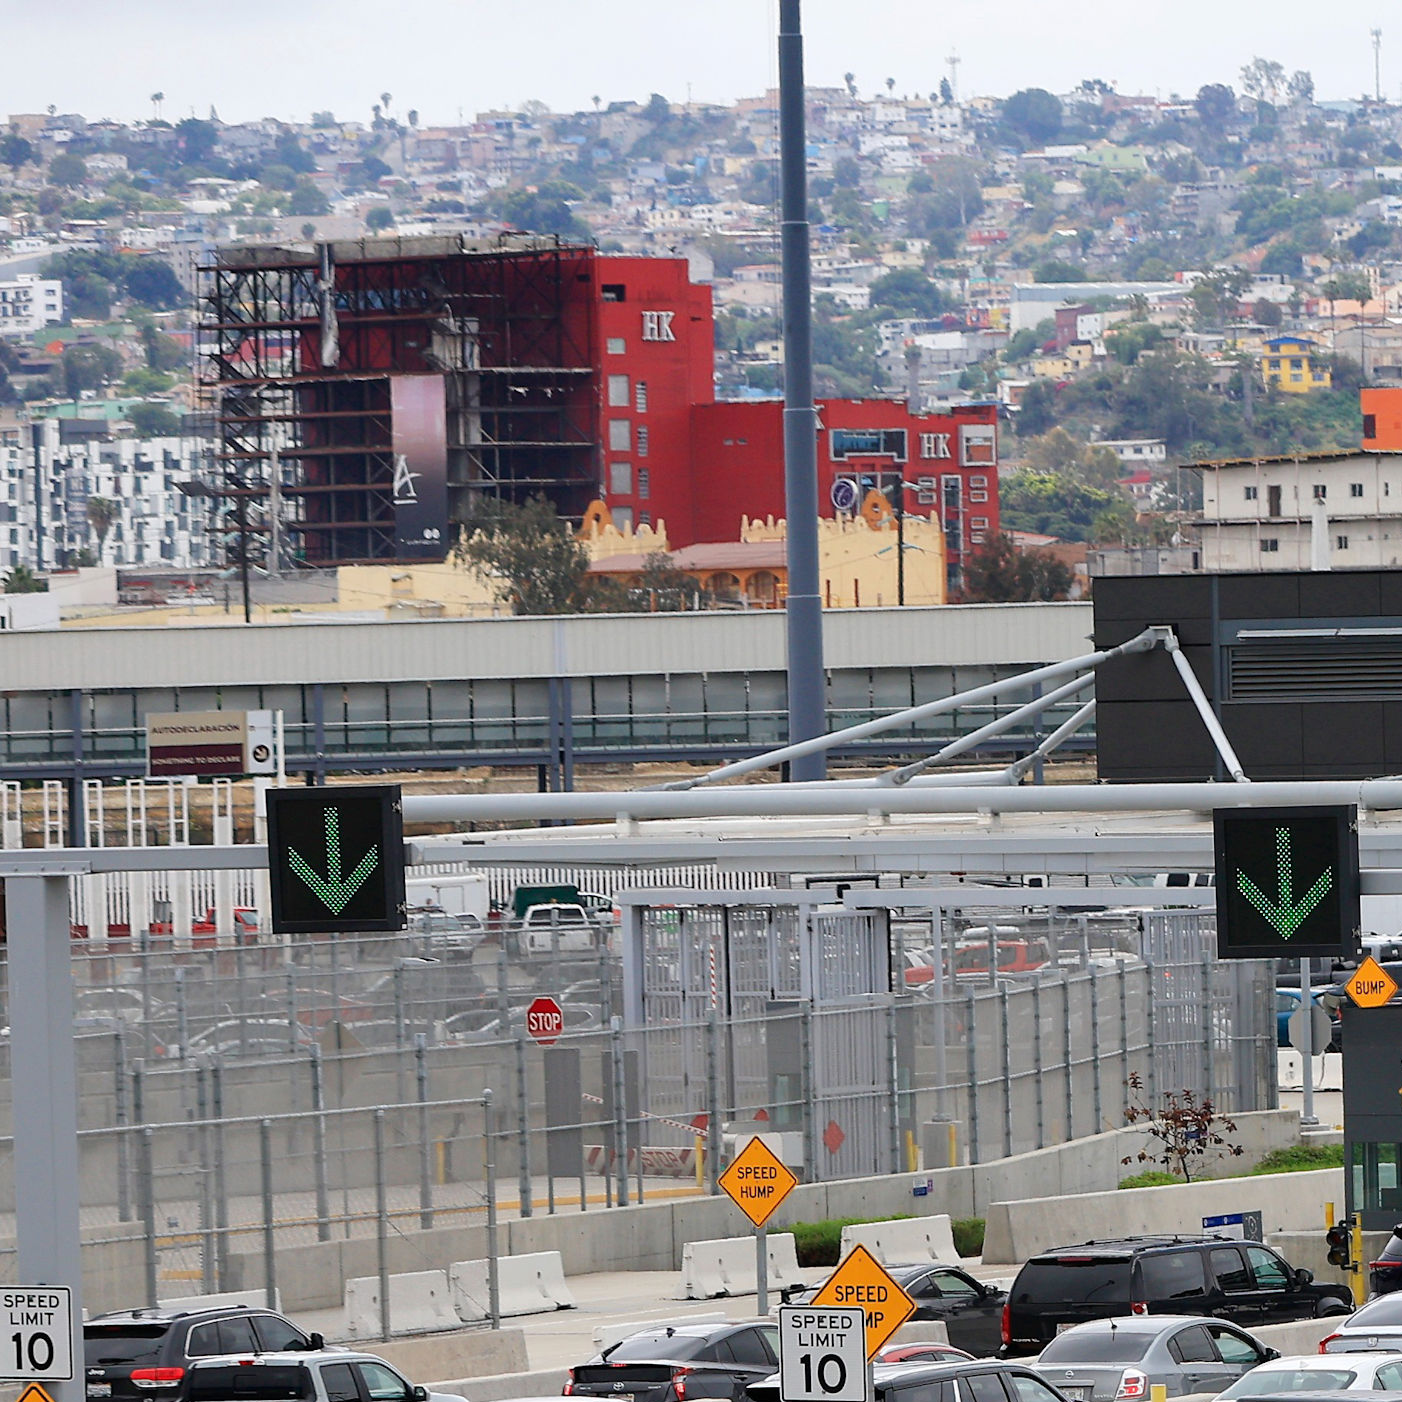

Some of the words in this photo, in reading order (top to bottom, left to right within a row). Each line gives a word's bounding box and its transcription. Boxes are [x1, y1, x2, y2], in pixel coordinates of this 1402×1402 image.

[642, 311, 676, 341] HK
[920, 433, 951, 459] HK
[1355, 981, 1386, 995] BUMP
[528, 1011, 559, 1031] STOP
[737, 1166, 777, 1180] SPEED
[740, 1186, 774, 1199] HUMP
[835, 1285, 888, 1302] SPEED
[3, 1295, 59, 1309] SPEED
[10, 1312, 54, 1326] LIMIT
[791, 1315, 853, 1330] SPEED
[865, 1311, 886, 1328] MP
[799, 1334, 846, 1348] LIMIT
[11, 1332, 54, 1371] 10
[800, 1354, 847, 1395] 10
